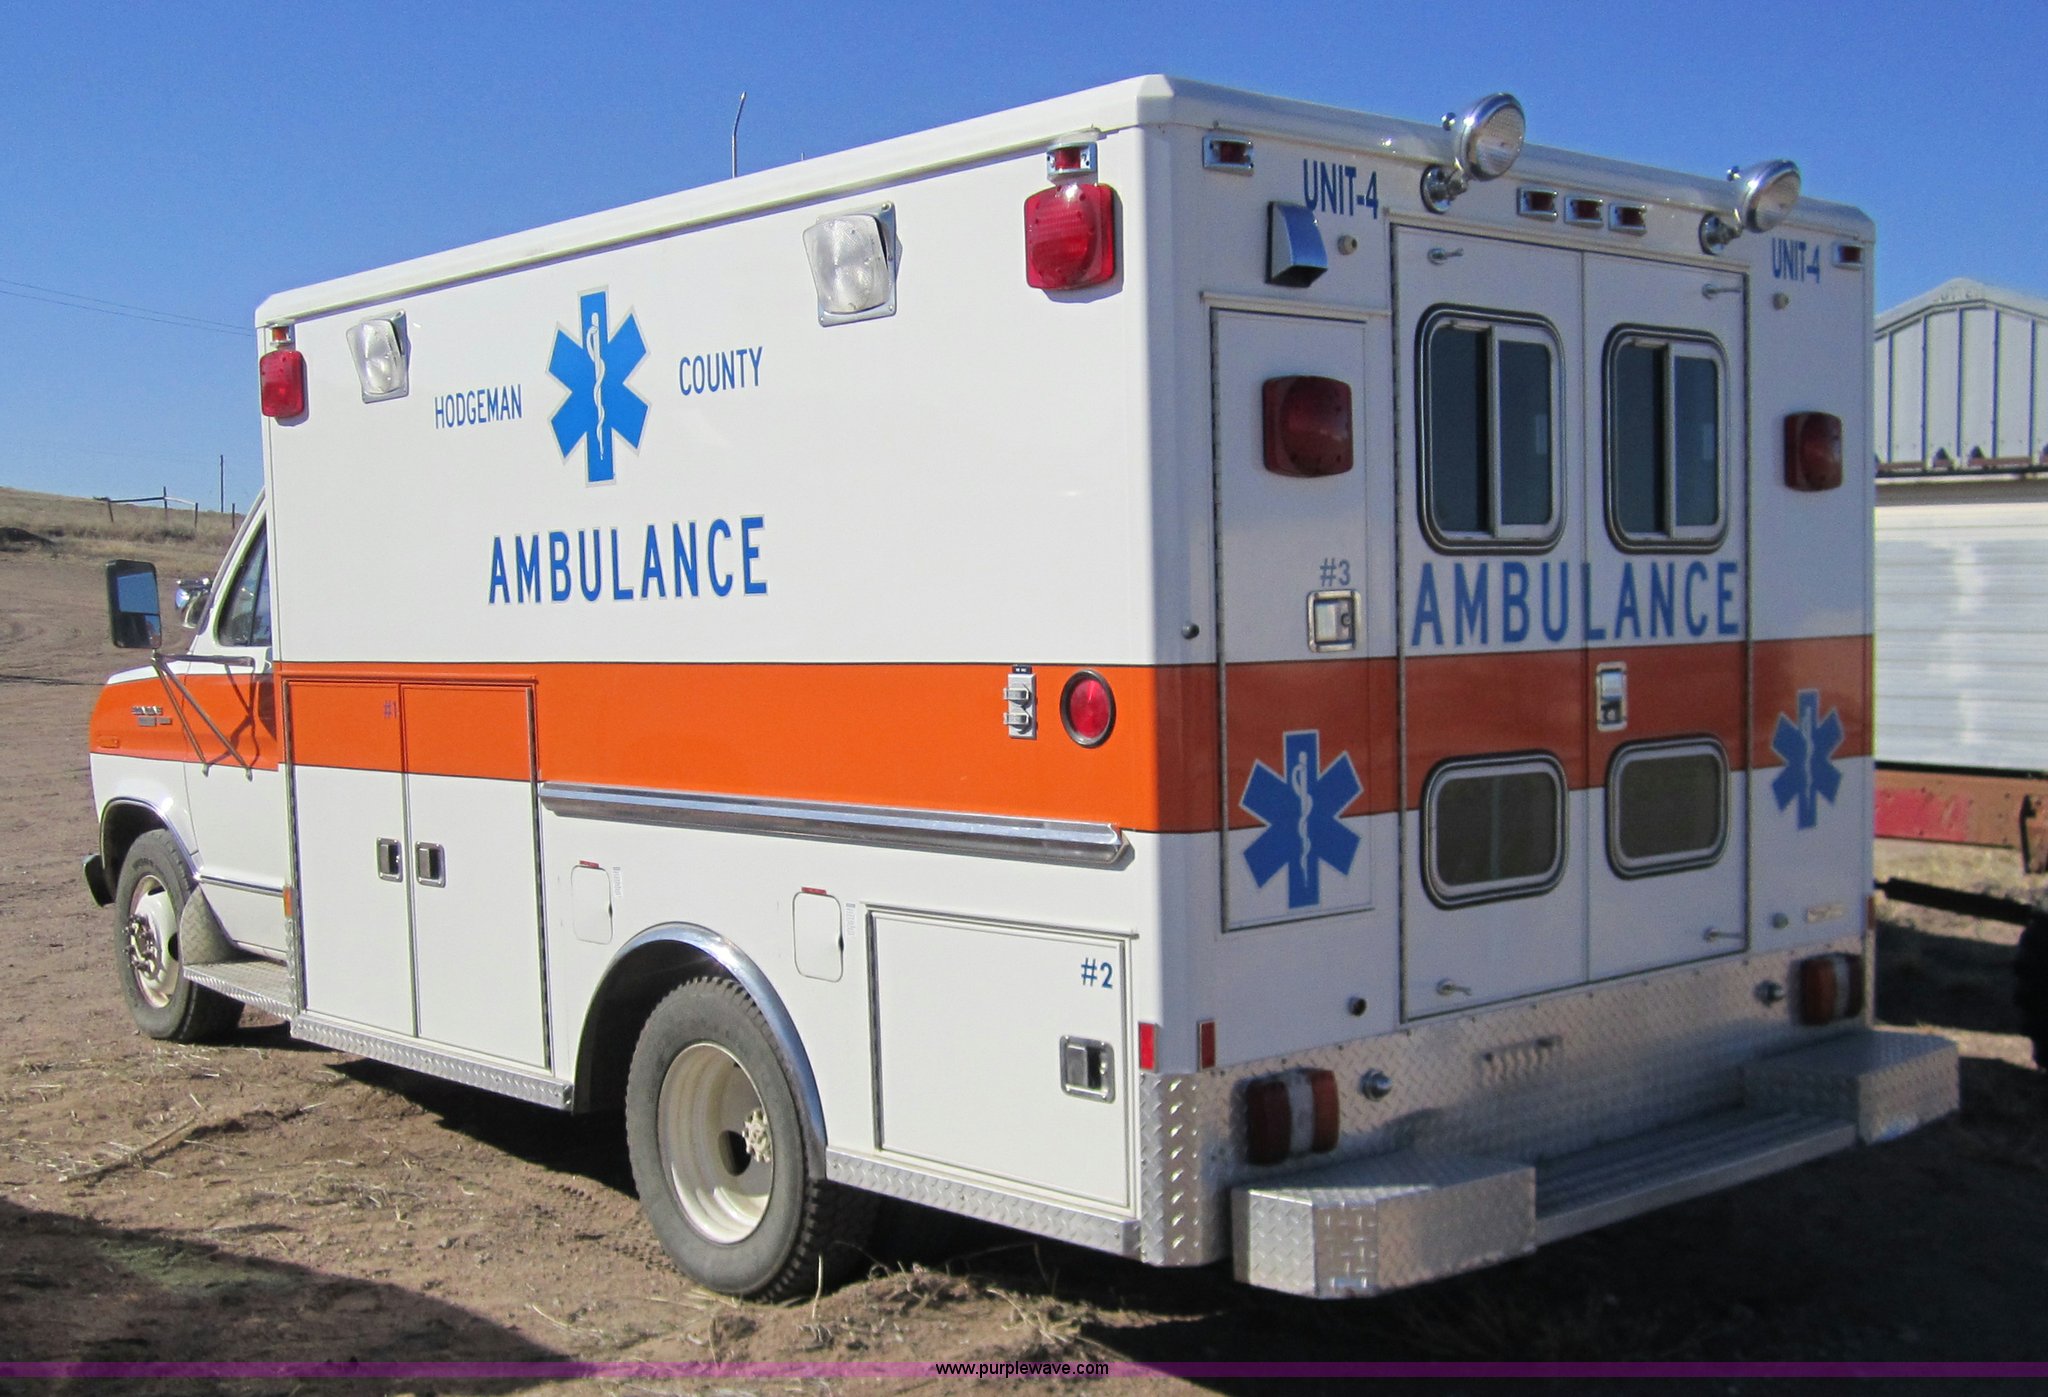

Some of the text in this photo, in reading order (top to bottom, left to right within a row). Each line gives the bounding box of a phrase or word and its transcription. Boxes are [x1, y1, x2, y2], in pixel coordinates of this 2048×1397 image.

[1303, 159, 1378, 219] UNIT-4
[435, 346, 763, 429] HODGEMAN COUNTY
[488, 514, 767, 605] AMBULANCE
[1319, 557, 1352, 587] #3
[1411, 561, 1739, 646] AMBULANCE
[1081, 957, 1113, 988] #2
